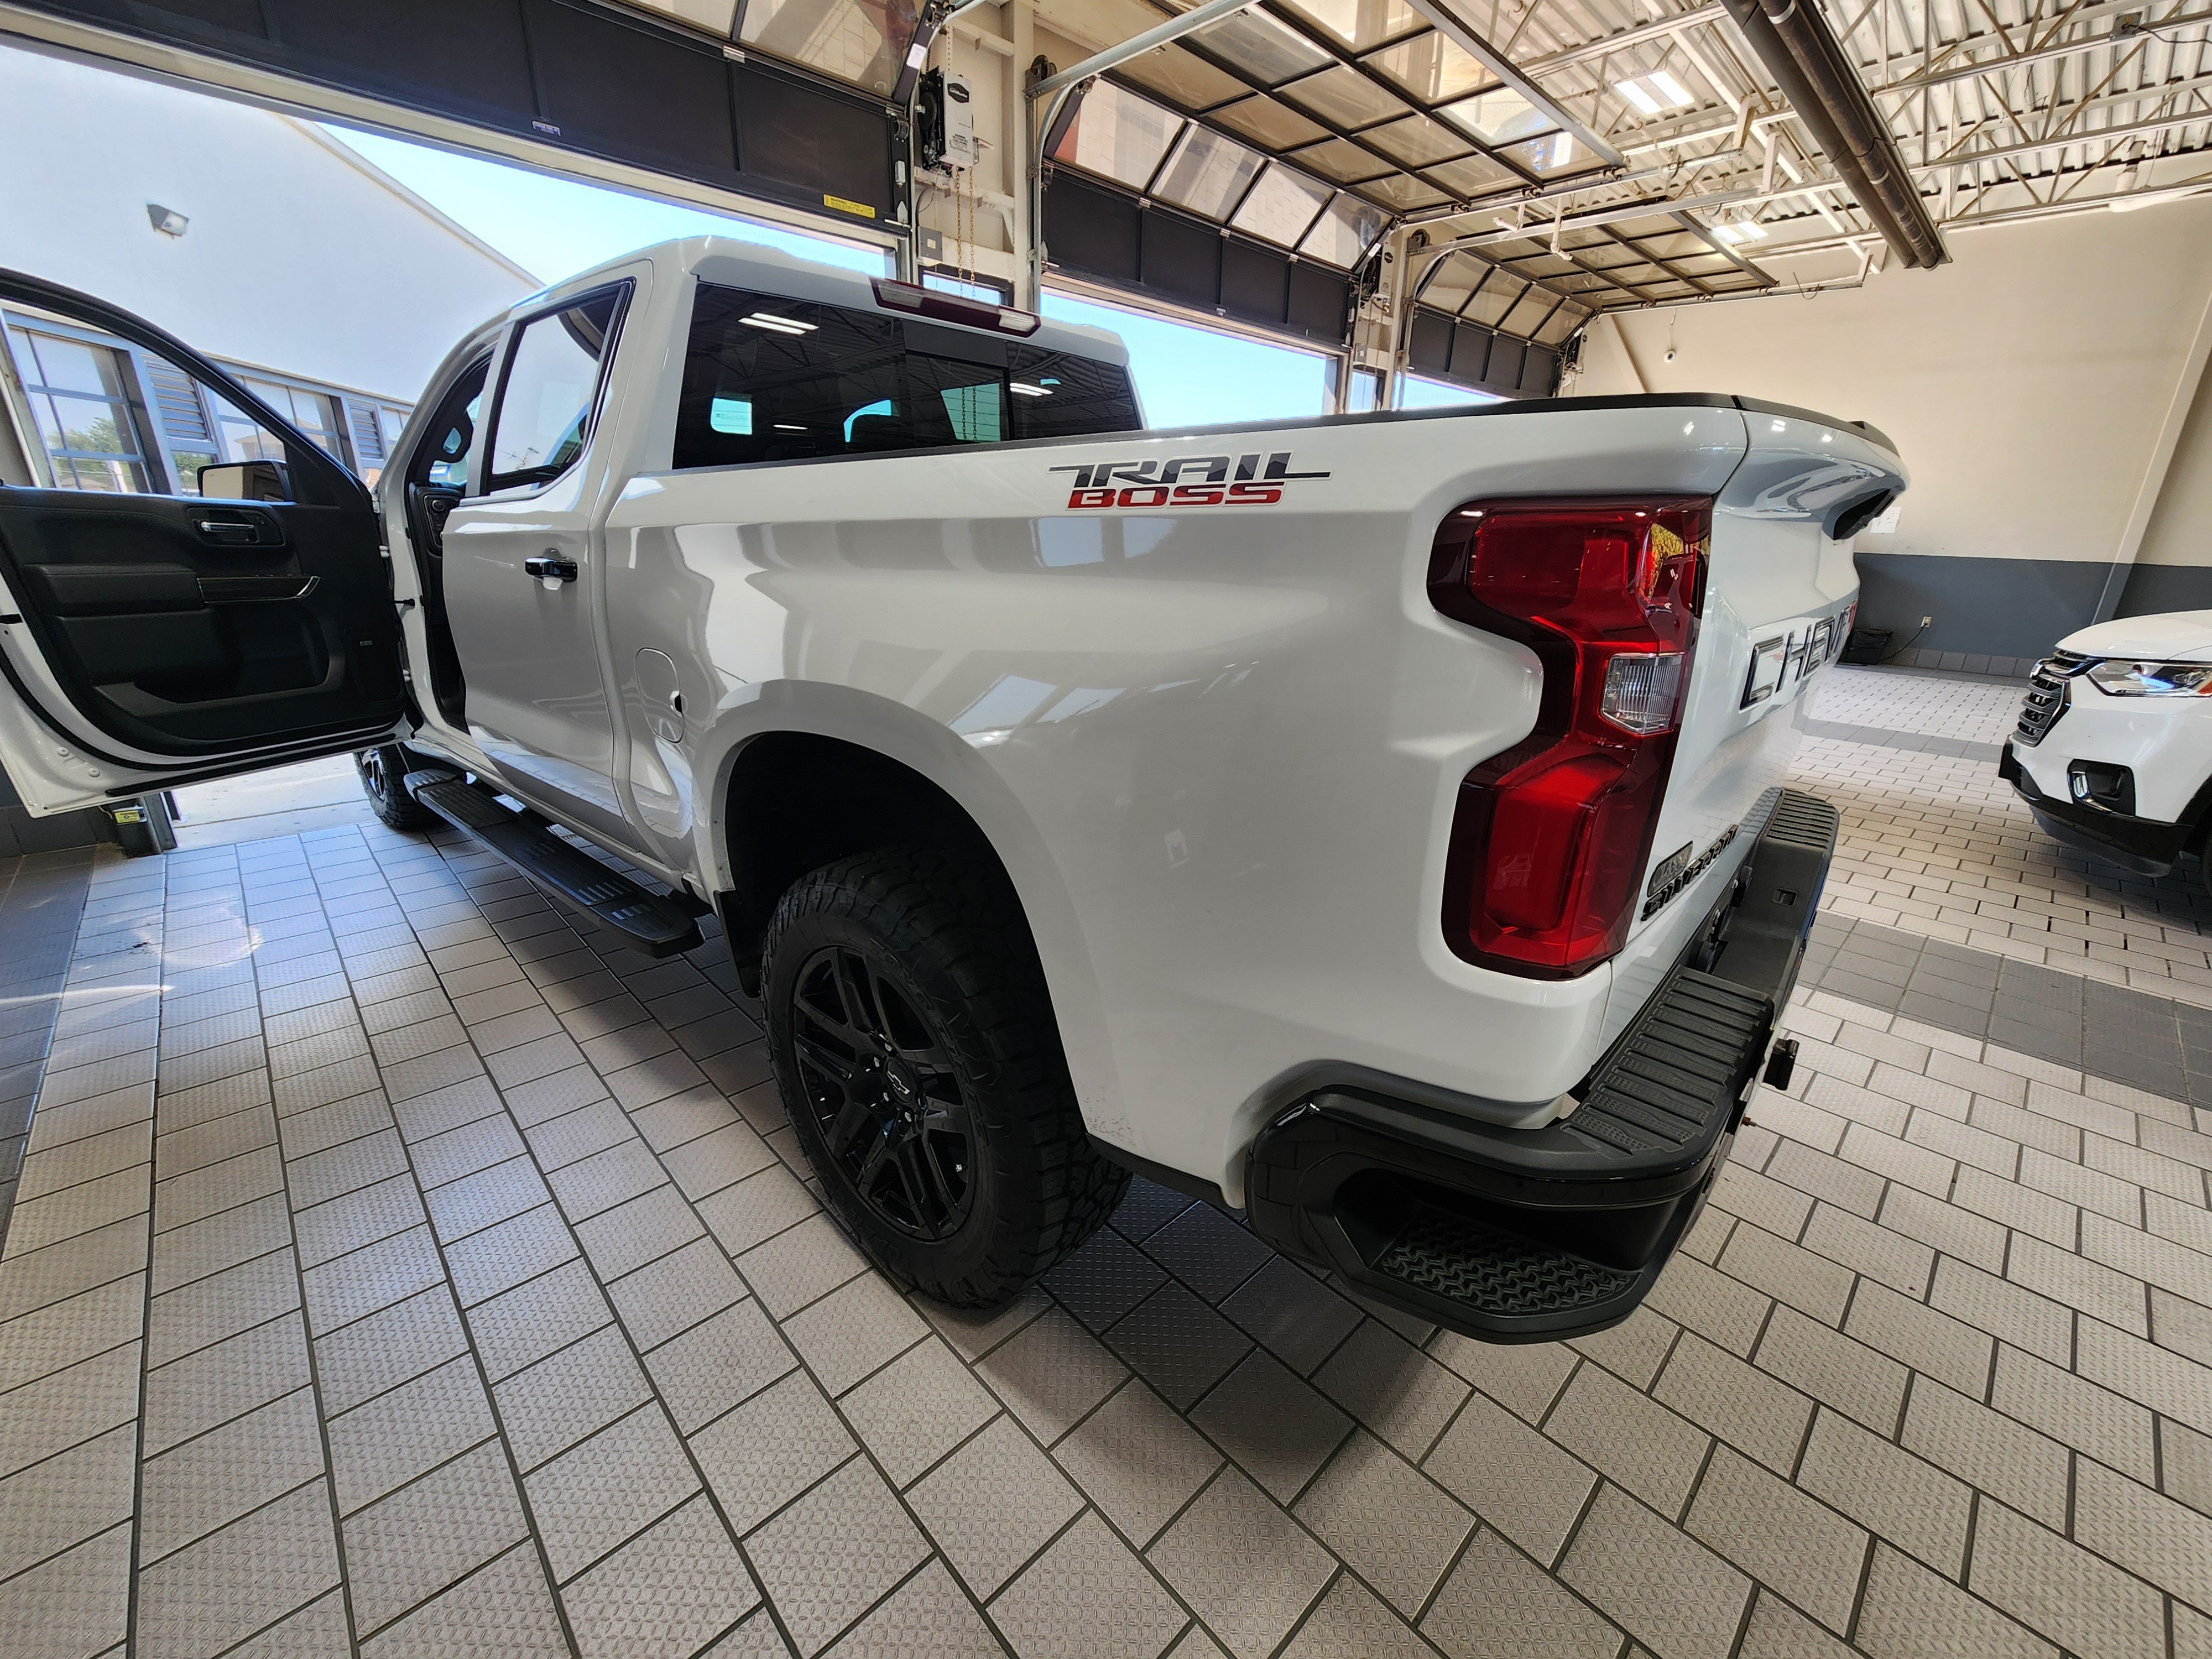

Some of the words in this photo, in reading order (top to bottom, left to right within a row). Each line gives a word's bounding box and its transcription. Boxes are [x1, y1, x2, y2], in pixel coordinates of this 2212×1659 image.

[1048, 451, 1332, 488] TRAIL
[1066, 481, 1285, 509] BOSS
[867, 936, 935, 1012] TOYO
[936, 1016, 989, 1146] TIRES
